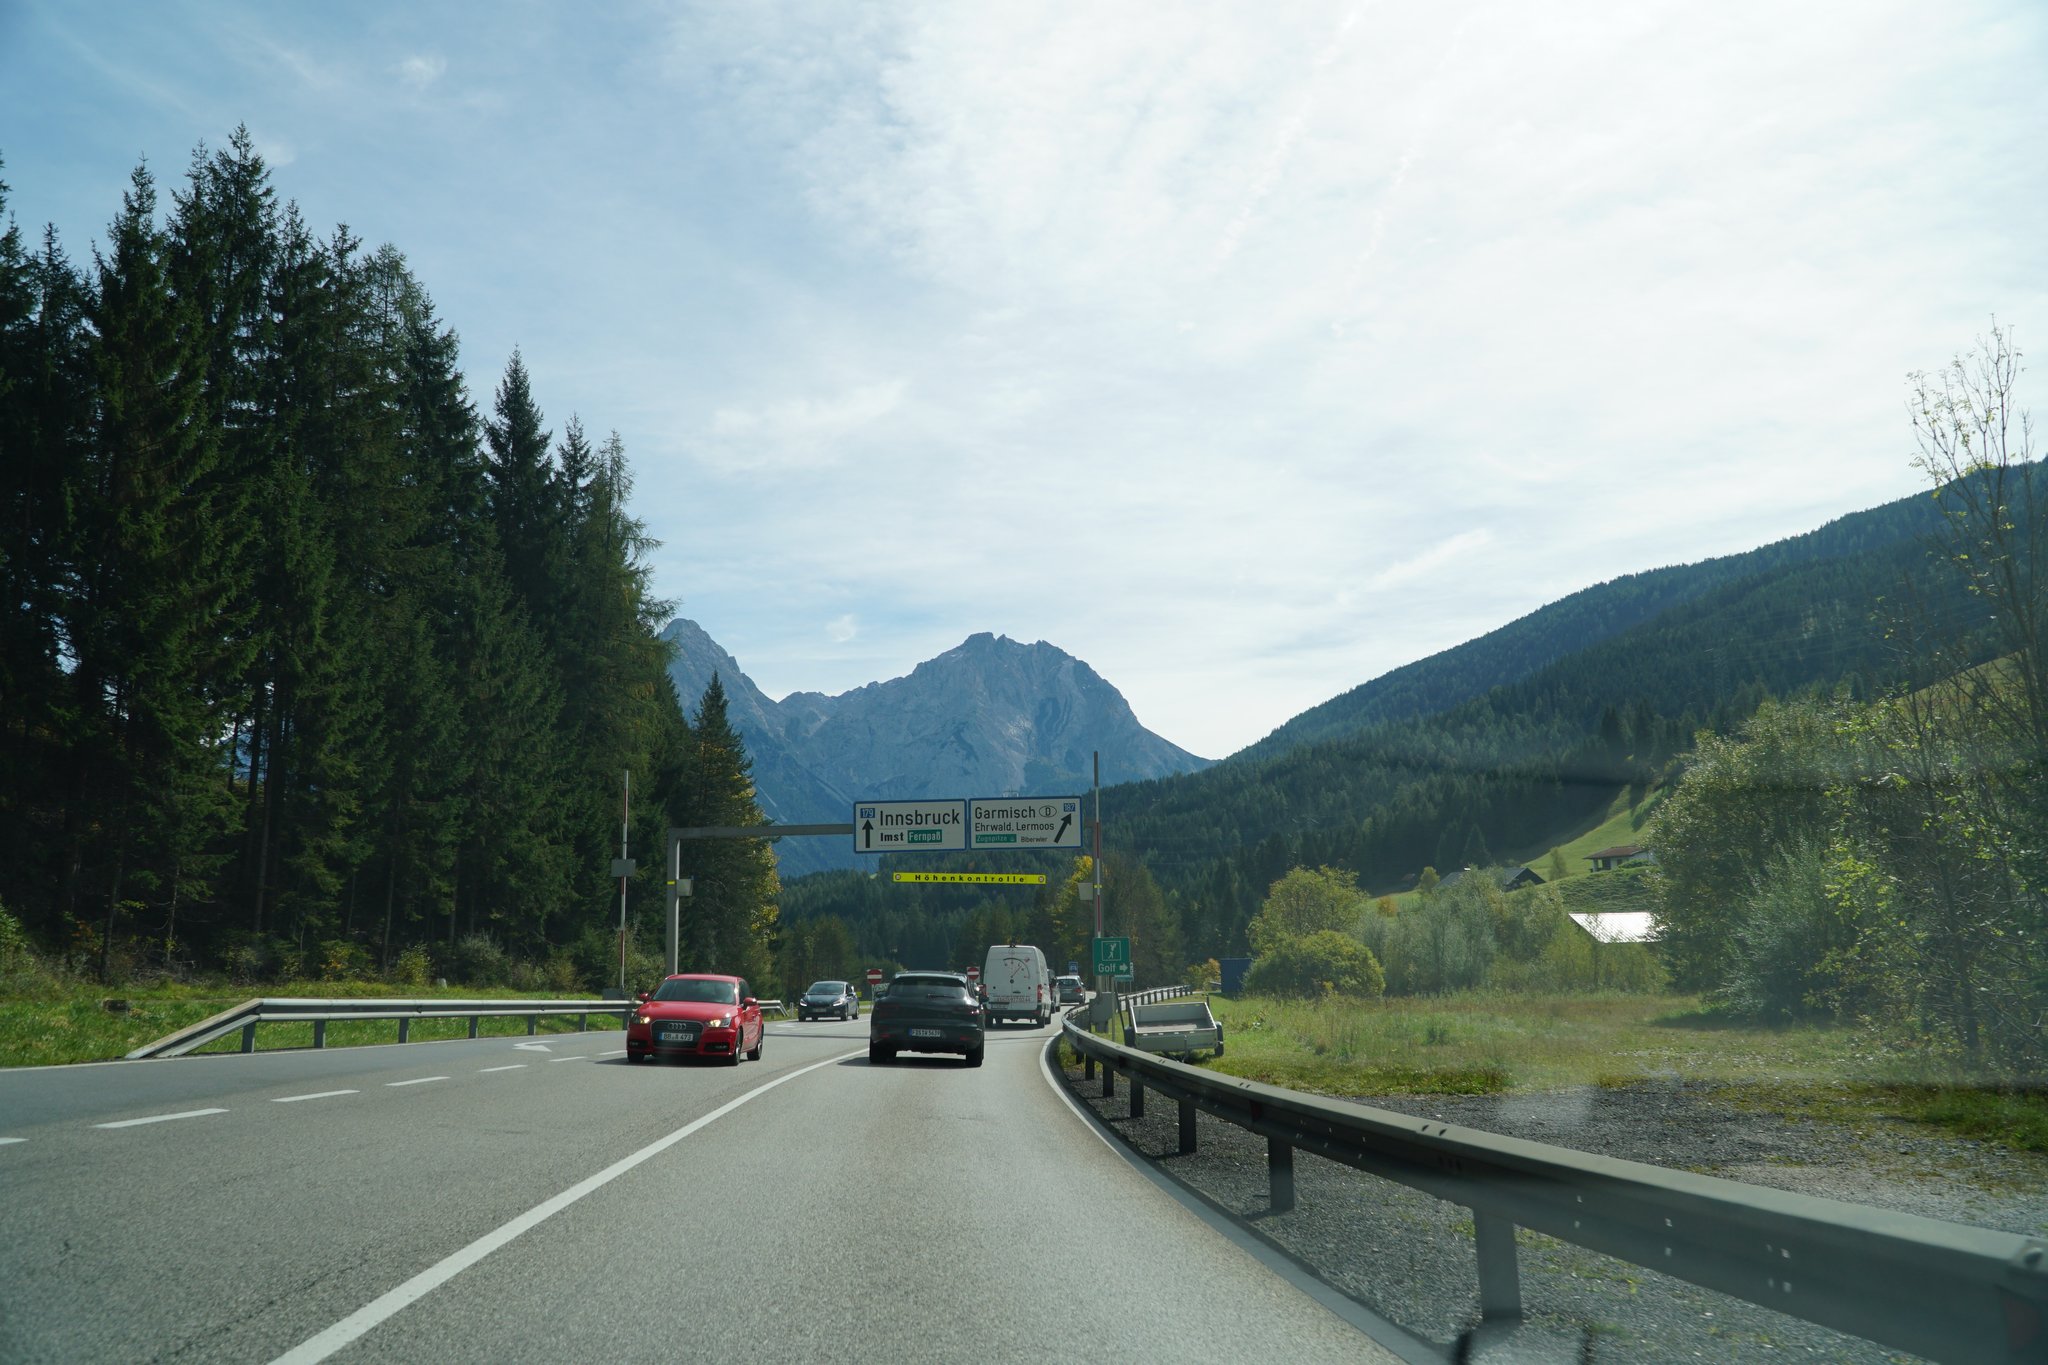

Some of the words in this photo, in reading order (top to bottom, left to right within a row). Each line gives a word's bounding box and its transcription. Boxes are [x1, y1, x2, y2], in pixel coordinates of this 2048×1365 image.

[975, 806, 1036, 819] Garmisch
[1065, 803, 1075, 812] 187
[862, 809, 874, 818] 179
[880, 809, 960, 826] Innsbruck
[975, 822, 1015, 832] Ehrwald,
[1016, 822, 1055, 831] Lermoos
[880, 832, 904, 842] Imst
[909, 831, 941, 841] Fernpaß
[915, 874, 1025, 883] Höhenkontrolle
[1098, 963, 1117, 973] Golf
